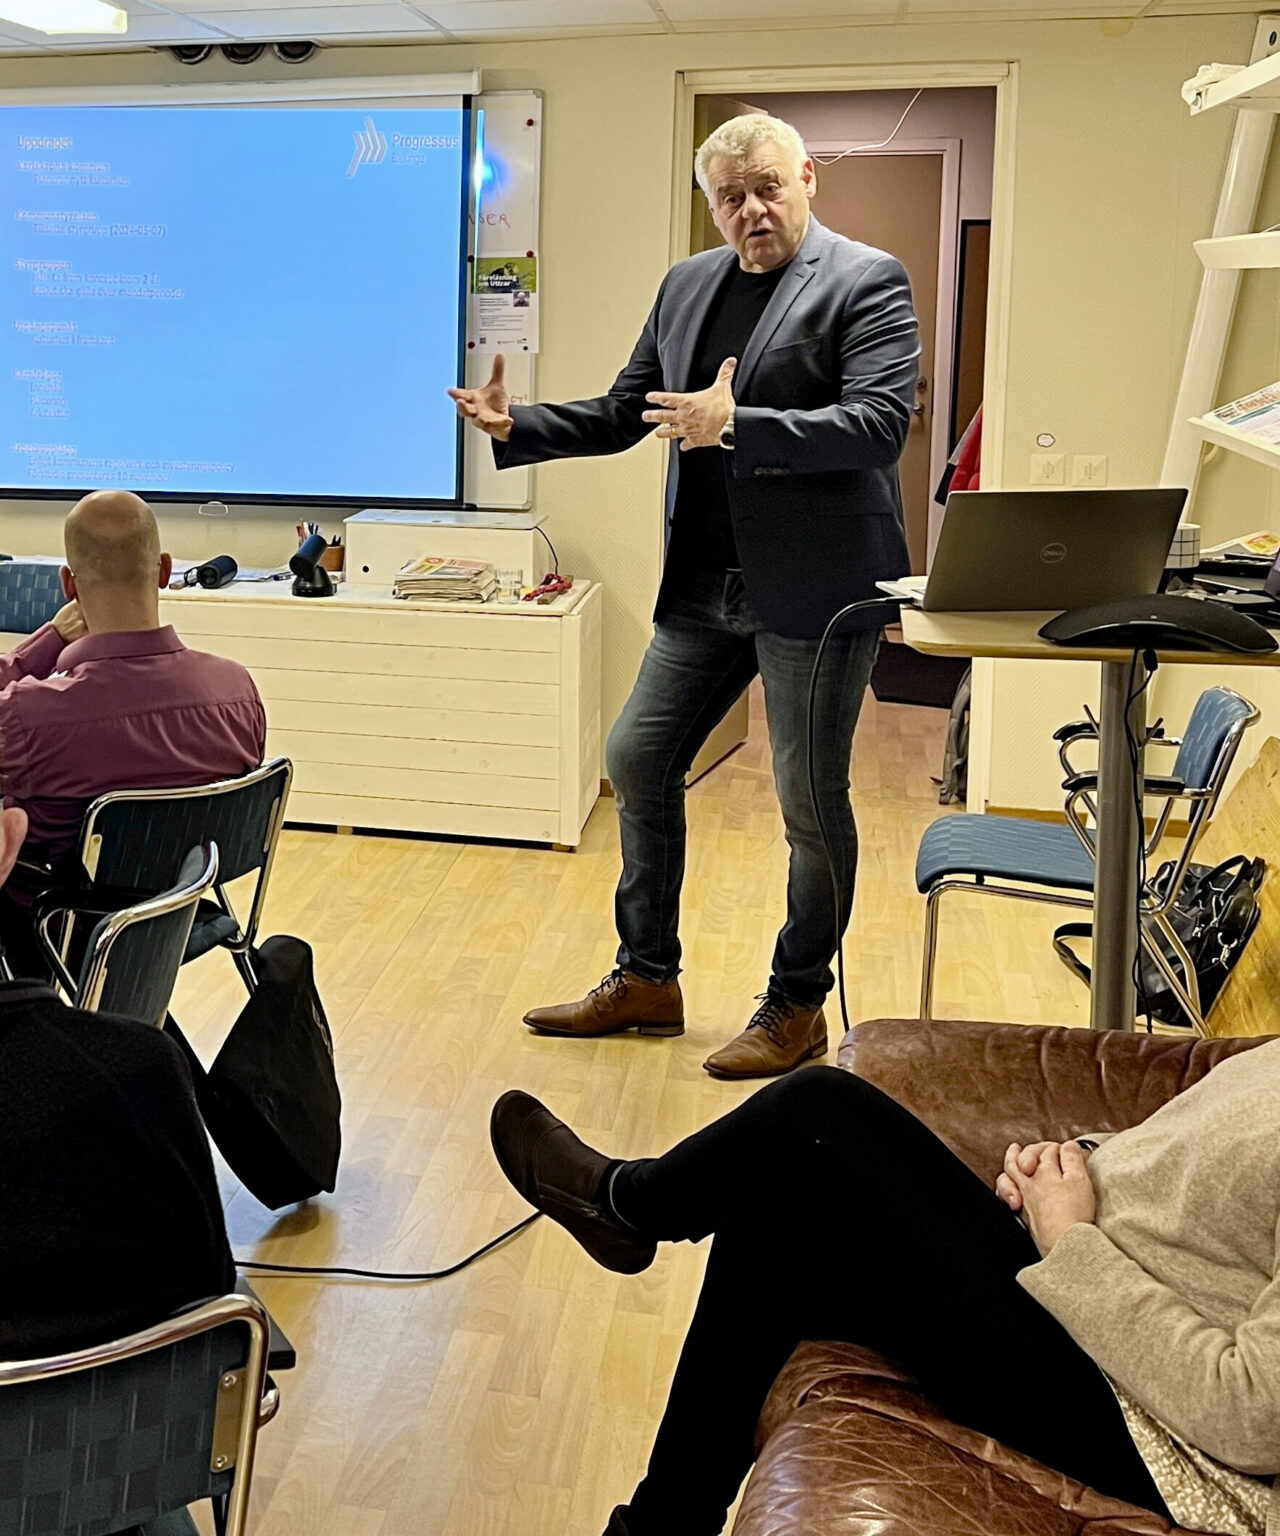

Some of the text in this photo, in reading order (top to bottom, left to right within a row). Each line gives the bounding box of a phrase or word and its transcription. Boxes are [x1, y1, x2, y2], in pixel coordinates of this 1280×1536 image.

[17, 135, 72, 151] Uppdraget
[392, 132, 459, 151] Progressus
[117, 471, 128, 481] 10
